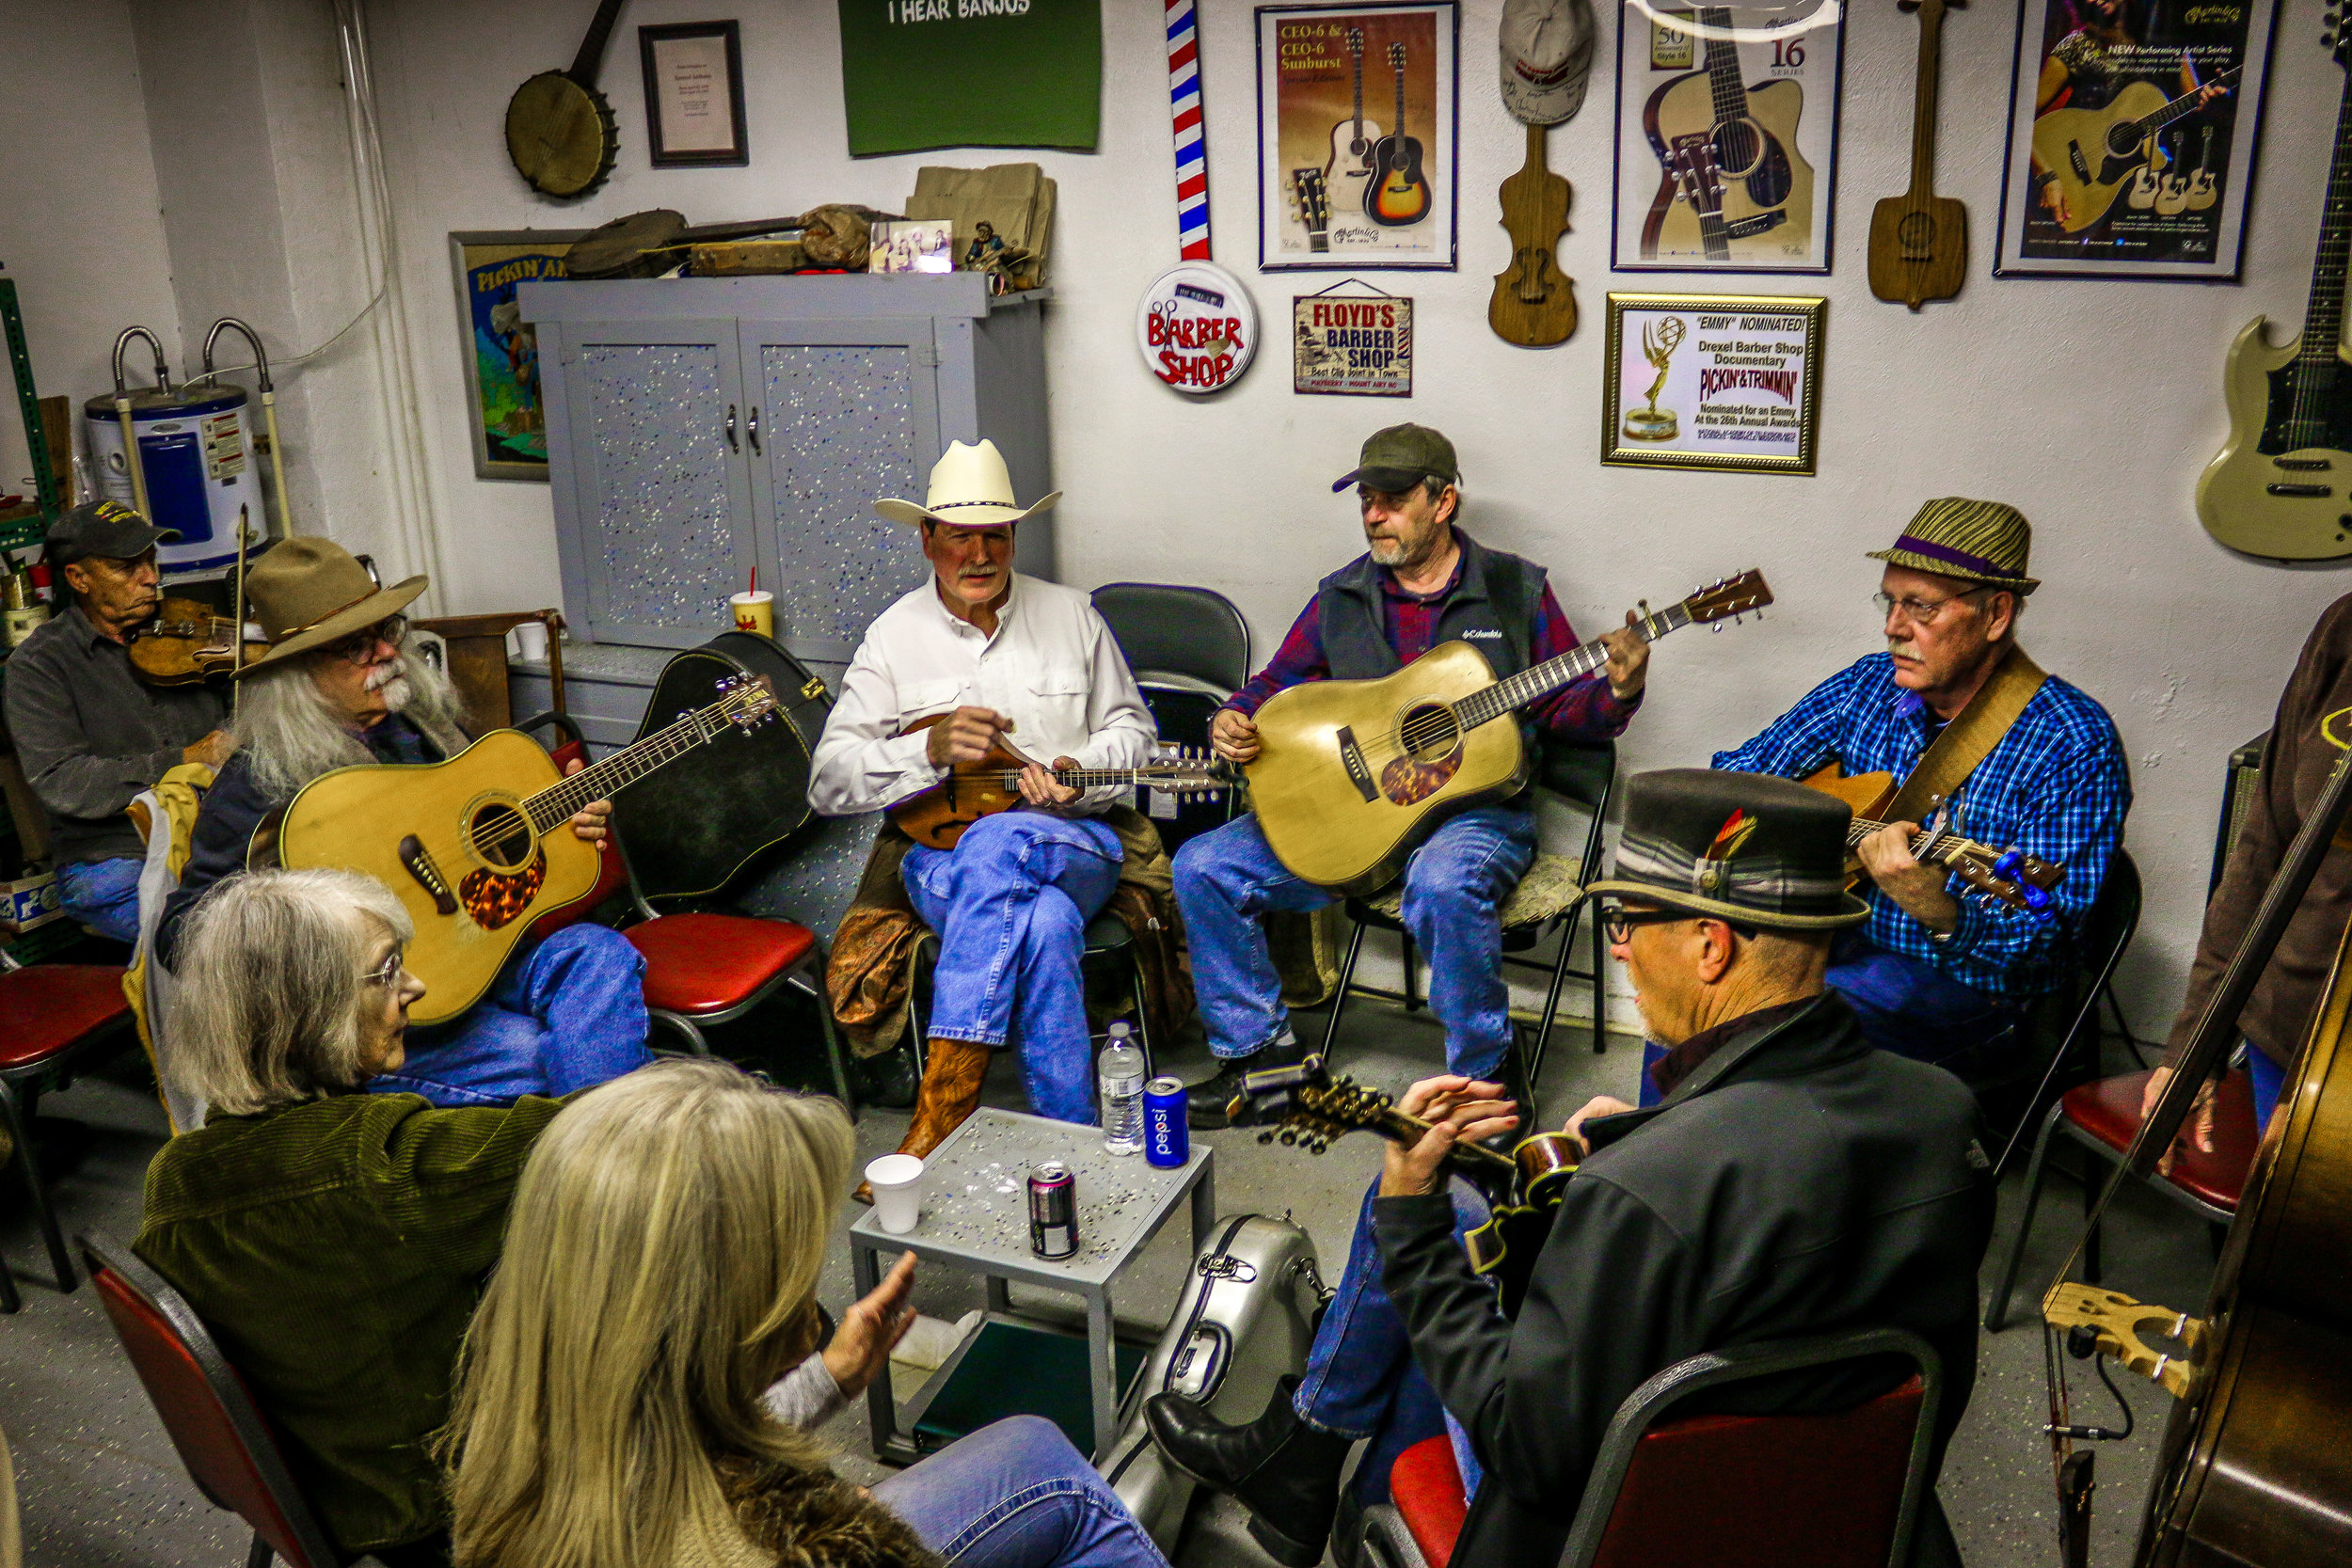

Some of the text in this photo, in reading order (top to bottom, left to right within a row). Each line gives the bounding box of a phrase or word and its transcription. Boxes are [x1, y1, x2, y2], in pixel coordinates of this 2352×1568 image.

[889, 0, 1030, 24] I HEAR BANJOS
[1280, 24, 1343, 40] CEO-6 &
[1280, 42, 1325, 56] CEO-6
[1770, 38, 1805, 68] 16
[2107, 45, 2233, 56] NEW Performing Artist Series
[1280, 56, 1342, 71] Sunburst
[477, 258, 542, 293] PICKIN'
[1313, 304, 1394, 328] FLOYD'S
[1697, 316, 1806, 332] "EMMY" NOMINATED!
[1149, 313, 1244, 349] BARBER
[1327, 328, 1394, 348] BARBER
[1698, 341, 1804, 356] Drexel Barber Shop
[1348, 348, 1394, 368] SHOP
[1714, 354, 1787, 369] Documentary
[1154, 351, 1233, 387] SHOP
[1311, 367, 1328, 376] Best
[1368, 369, 1375, 377] in
[1378, 369, 1398, 378] Town
[1700, 404, 1796, 419] Nominated for an Emmy
[1694, 415, 1801, 428] At the 26th Annual Awards
[1152, 1108, 1172, 1155] pepsi
